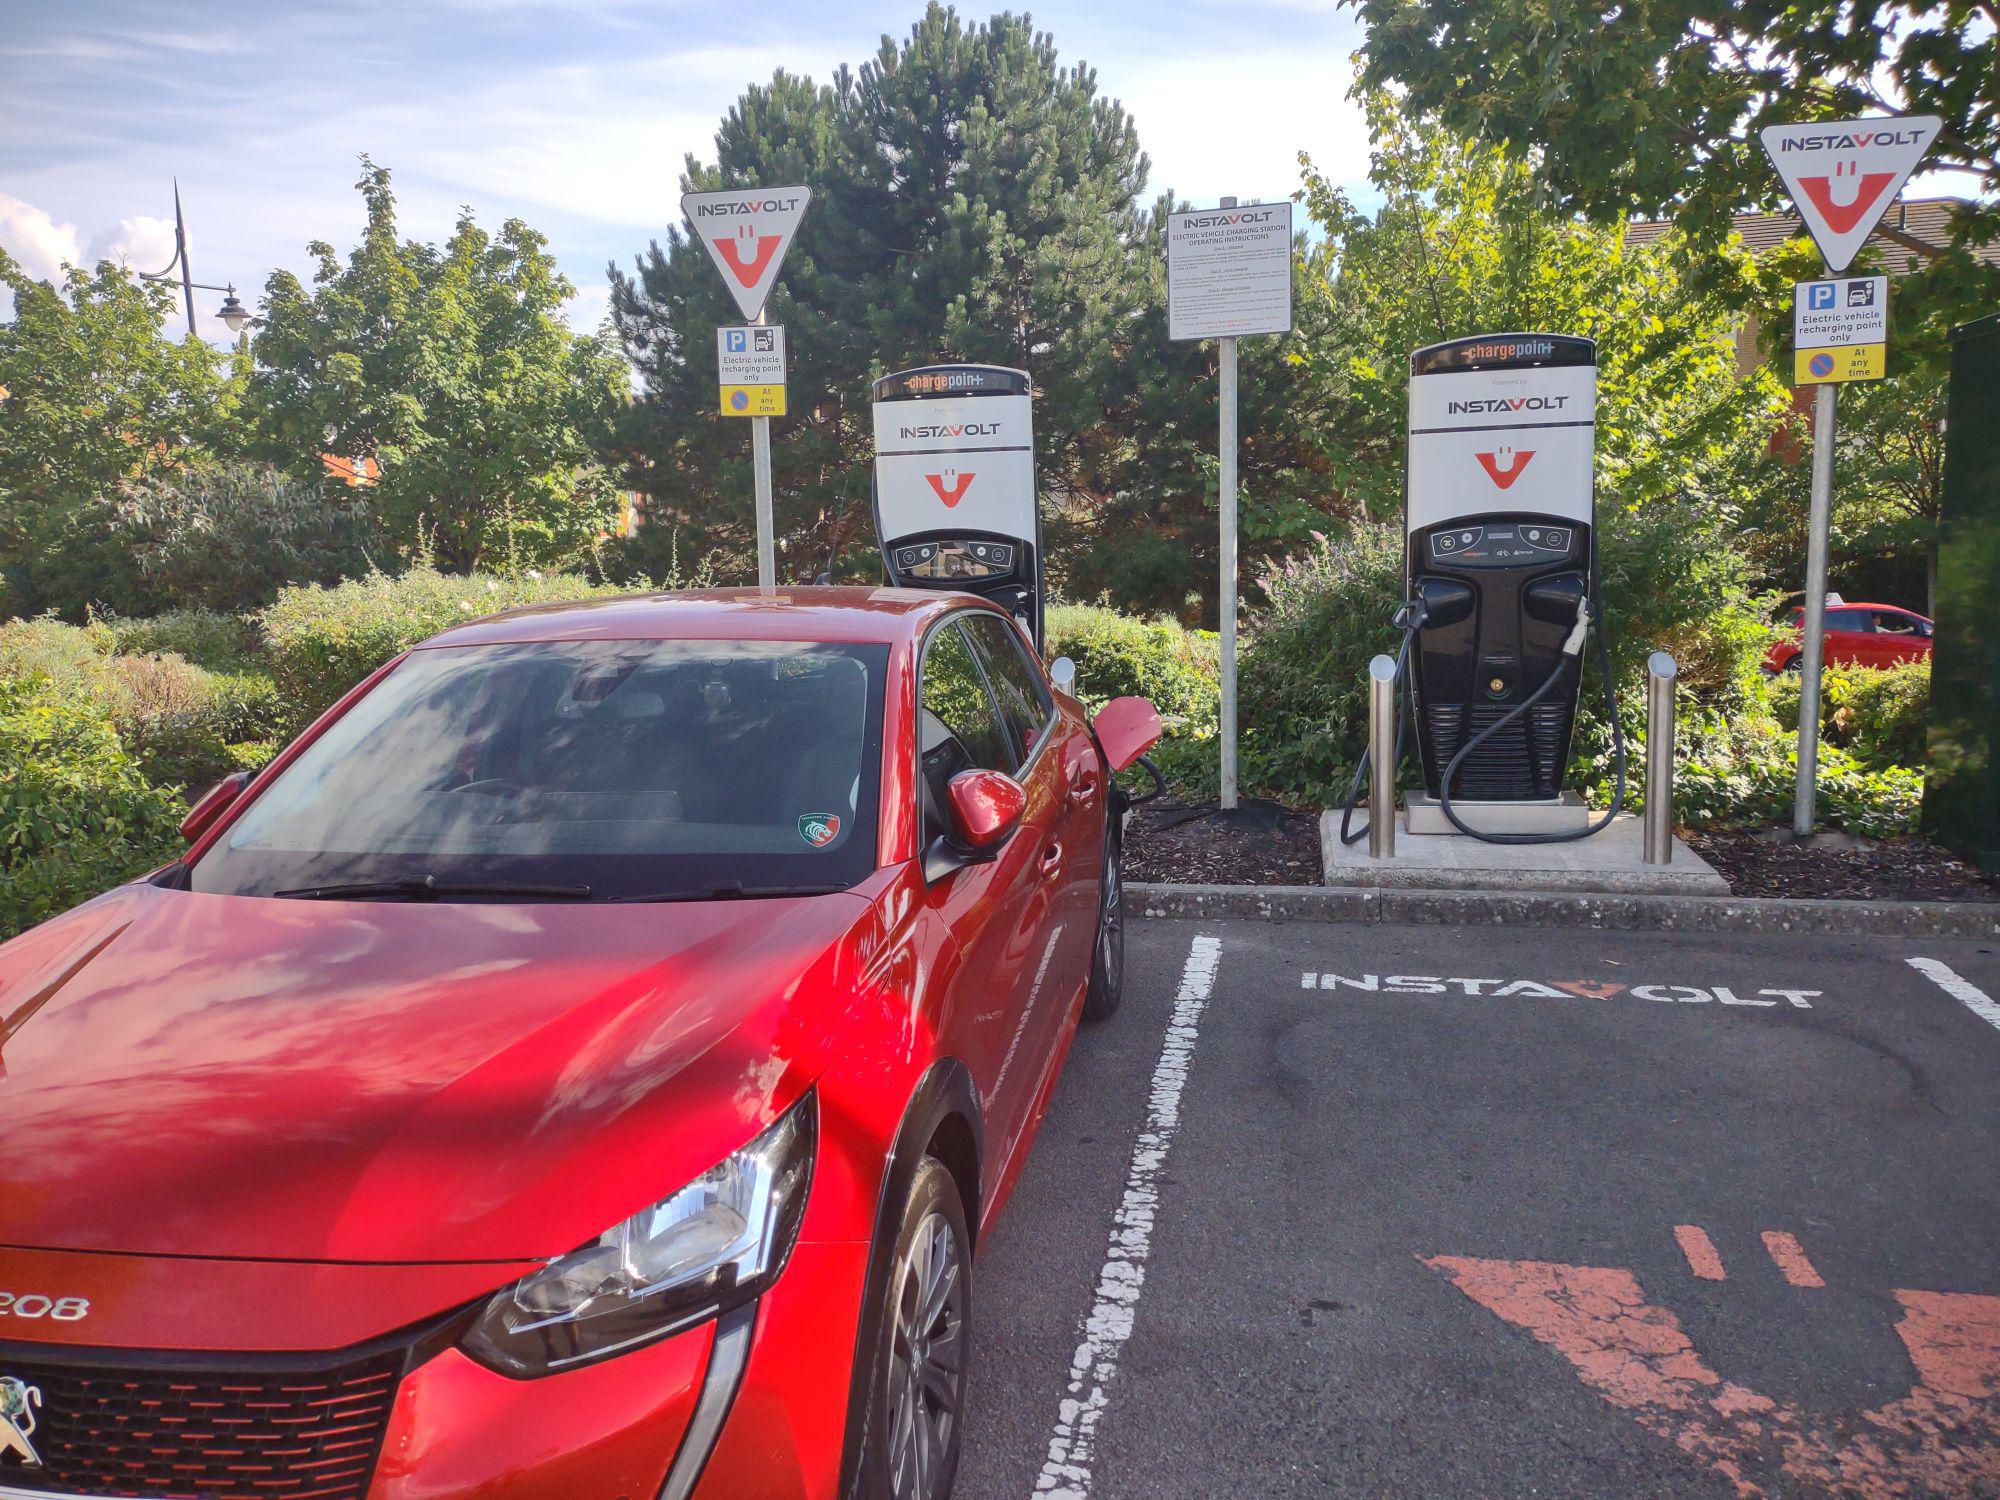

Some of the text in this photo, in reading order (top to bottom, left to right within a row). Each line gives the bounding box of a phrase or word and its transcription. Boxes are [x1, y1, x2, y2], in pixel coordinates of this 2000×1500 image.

[1781, 130, 1926, 152] INSTAVOLT
[698, 198, 799, 217] INSTAVOLT
[1184, 211, 1273, 229] INSTAVOLT
[1173, 224, 1286, 241] ELECTRIC VEHICLE CHARGING STATION
[1189, 233, 1270, 246] OPERATING INSTRUCTIONS
[1815, 286, 1832, 308] P
[1802, 311, 1880, 324] Electric vehicle
[1799, 321, 1882, 334] recharging point
[731, 332, 743, 350] P
[1829, 333, 1851, 342] only
[1854, 348, 1866, 356] At
[723, 355, 780, 364] Electric vehicle
[1851, 359, 1869, 367] any
[721, 364, 782, 374] recharging point
[1848, 368, 1871, 377] time
[744, 373, 760, 382] only
[762, 387, 771, 395] At
[760, 396, 774, 405] any
[1448, 395, 1570, 415] INSTAVOLT
[900, 422, 1001, 439] INSTAVOLT
[1301, 972, 1823, 1009] INSTAVOLT
